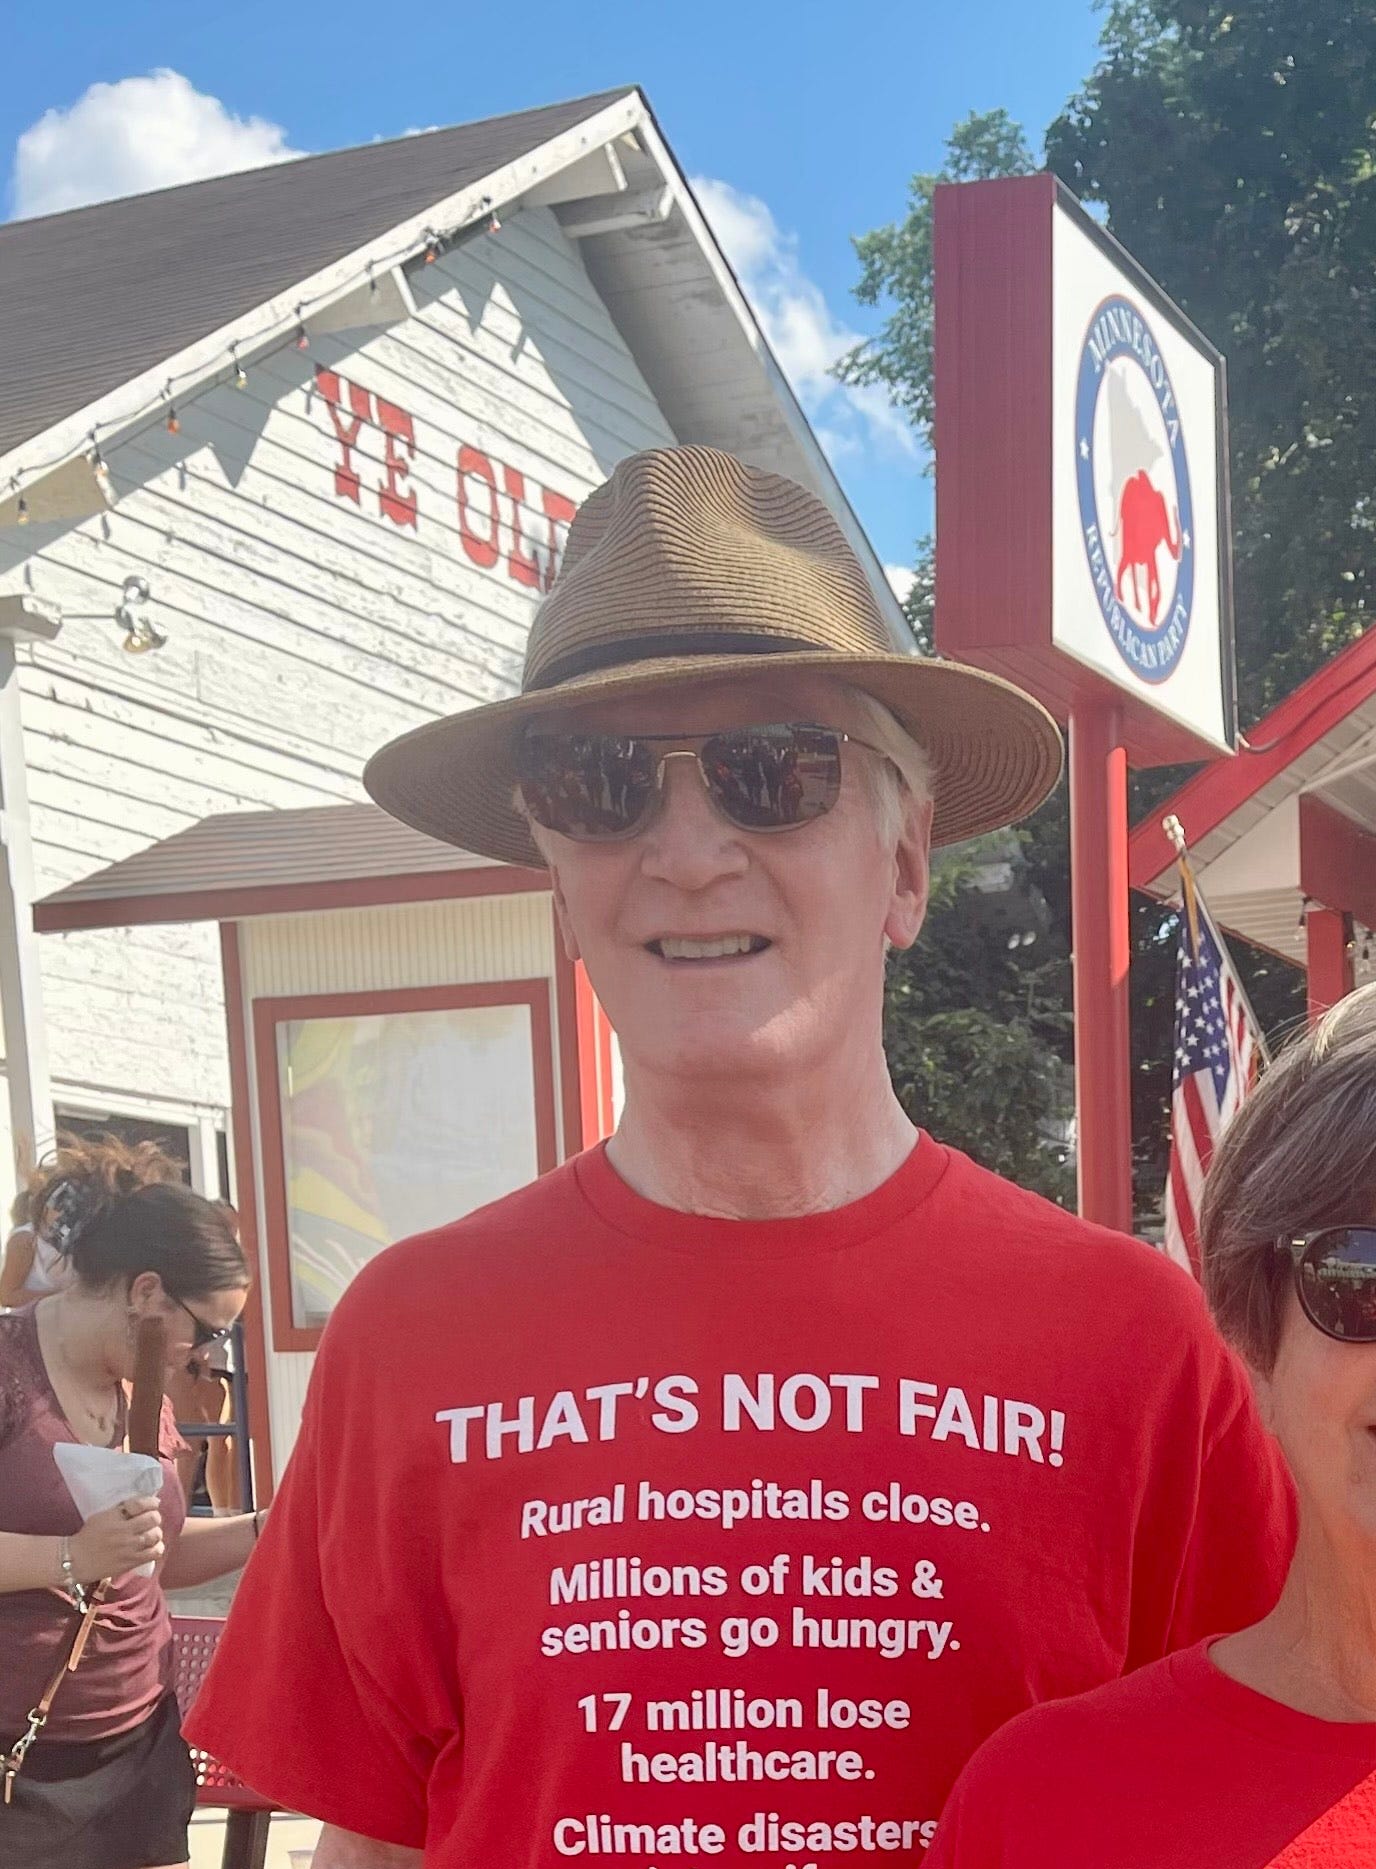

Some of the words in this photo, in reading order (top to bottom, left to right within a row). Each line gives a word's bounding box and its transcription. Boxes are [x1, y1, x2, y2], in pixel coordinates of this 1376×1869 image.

[1088, 307, 1179, 448] MINNESOTA
[314, 363, 418, 533] YE
[435, 1375, 699, 1463] THAT'S
[722, 1373, 879, 1432] NOT
[900, 1378, 1066, 1467] FAIR!
[520, 1483, 625, 1539] Rural
[638, 1478, 850, 1530] hospitals
[862, 1482, 991, 1532] close.
[549, 1556, 728, 1606] Millions
[740, 1553, 790, 1597] of
[802, 1555, 899, 1598] kids
[911, 1559, 944, 1599] &
[540, 1610, 707, 1657] seniors
[721, 1617, 778, 1658] go
[792, 1608, 961, 1660] hungry.
[578, 1693, 632, 1733] 17
[647, 1689, 803, 1731] million
[817, 1688, 911, 1730] lose
[621, 1741, 876, 1783] healthcare.
[553, 1814, 726, 1856] Climate
